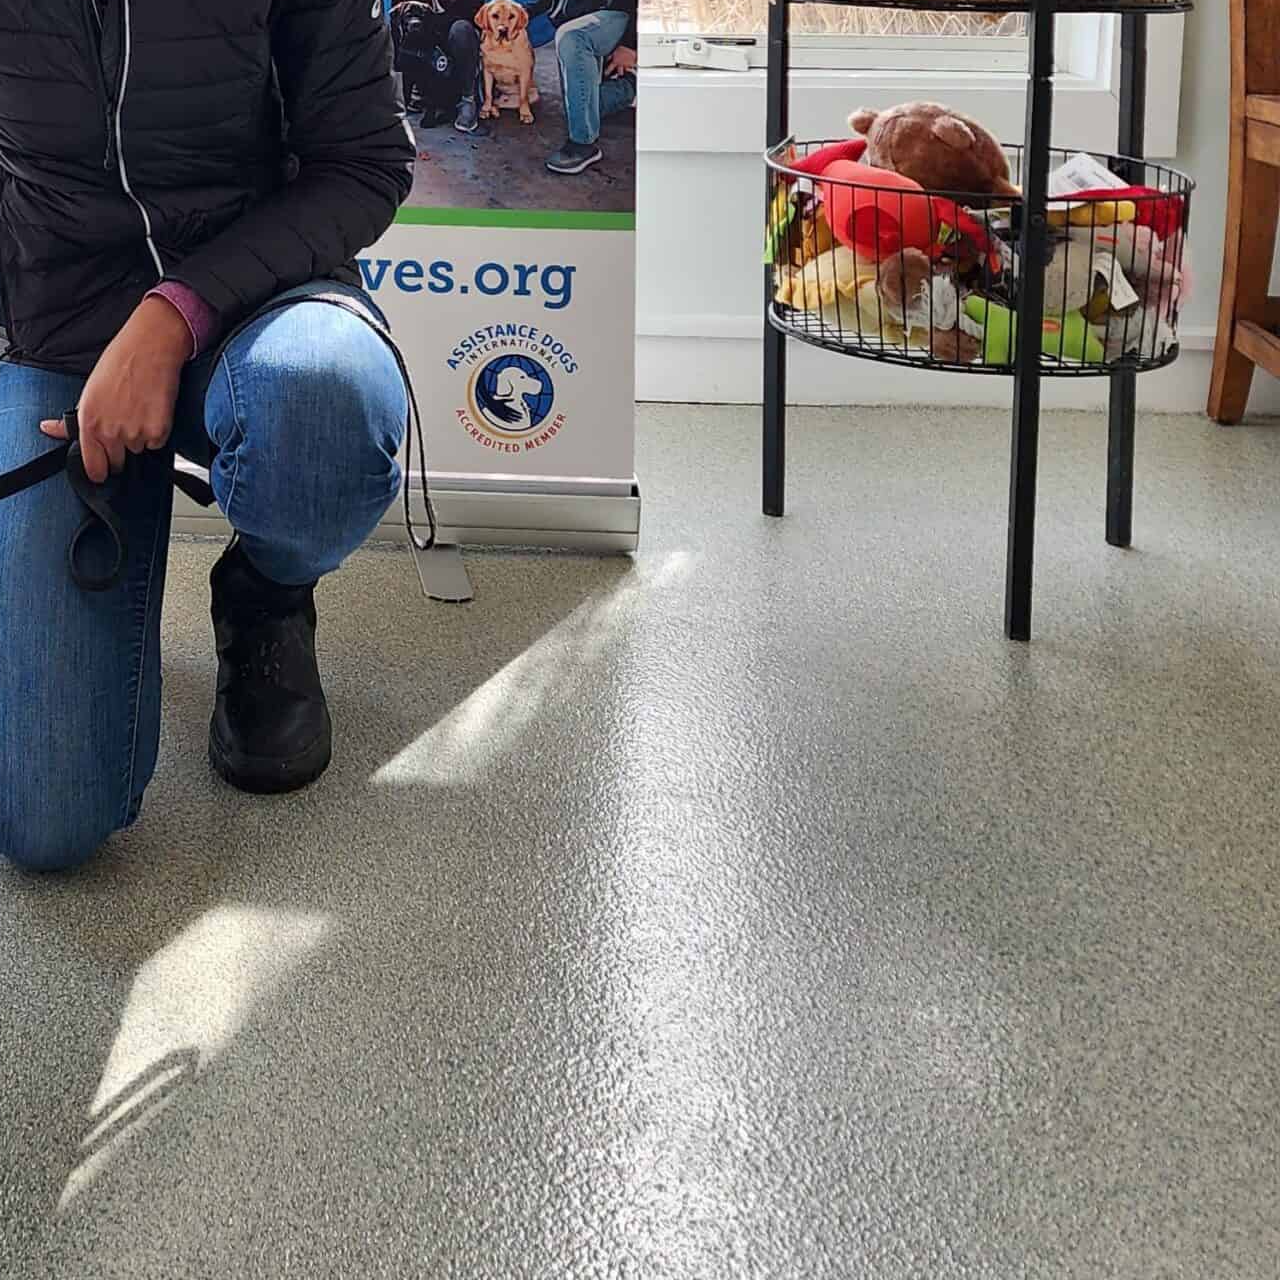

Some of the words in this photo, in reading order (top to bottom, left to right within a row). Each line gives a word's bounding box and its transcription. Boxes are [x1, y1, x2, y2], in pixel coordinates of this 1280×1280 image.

[447, 323, 539, 371] ASSISTANCE
[540, 333, 579, 374] DOGS
[465, 338, 559, 368] INTERNATIONAL
[456, 408, 521, 453] ACCREDITED
[524, 413, 567, 451] MEMBER
